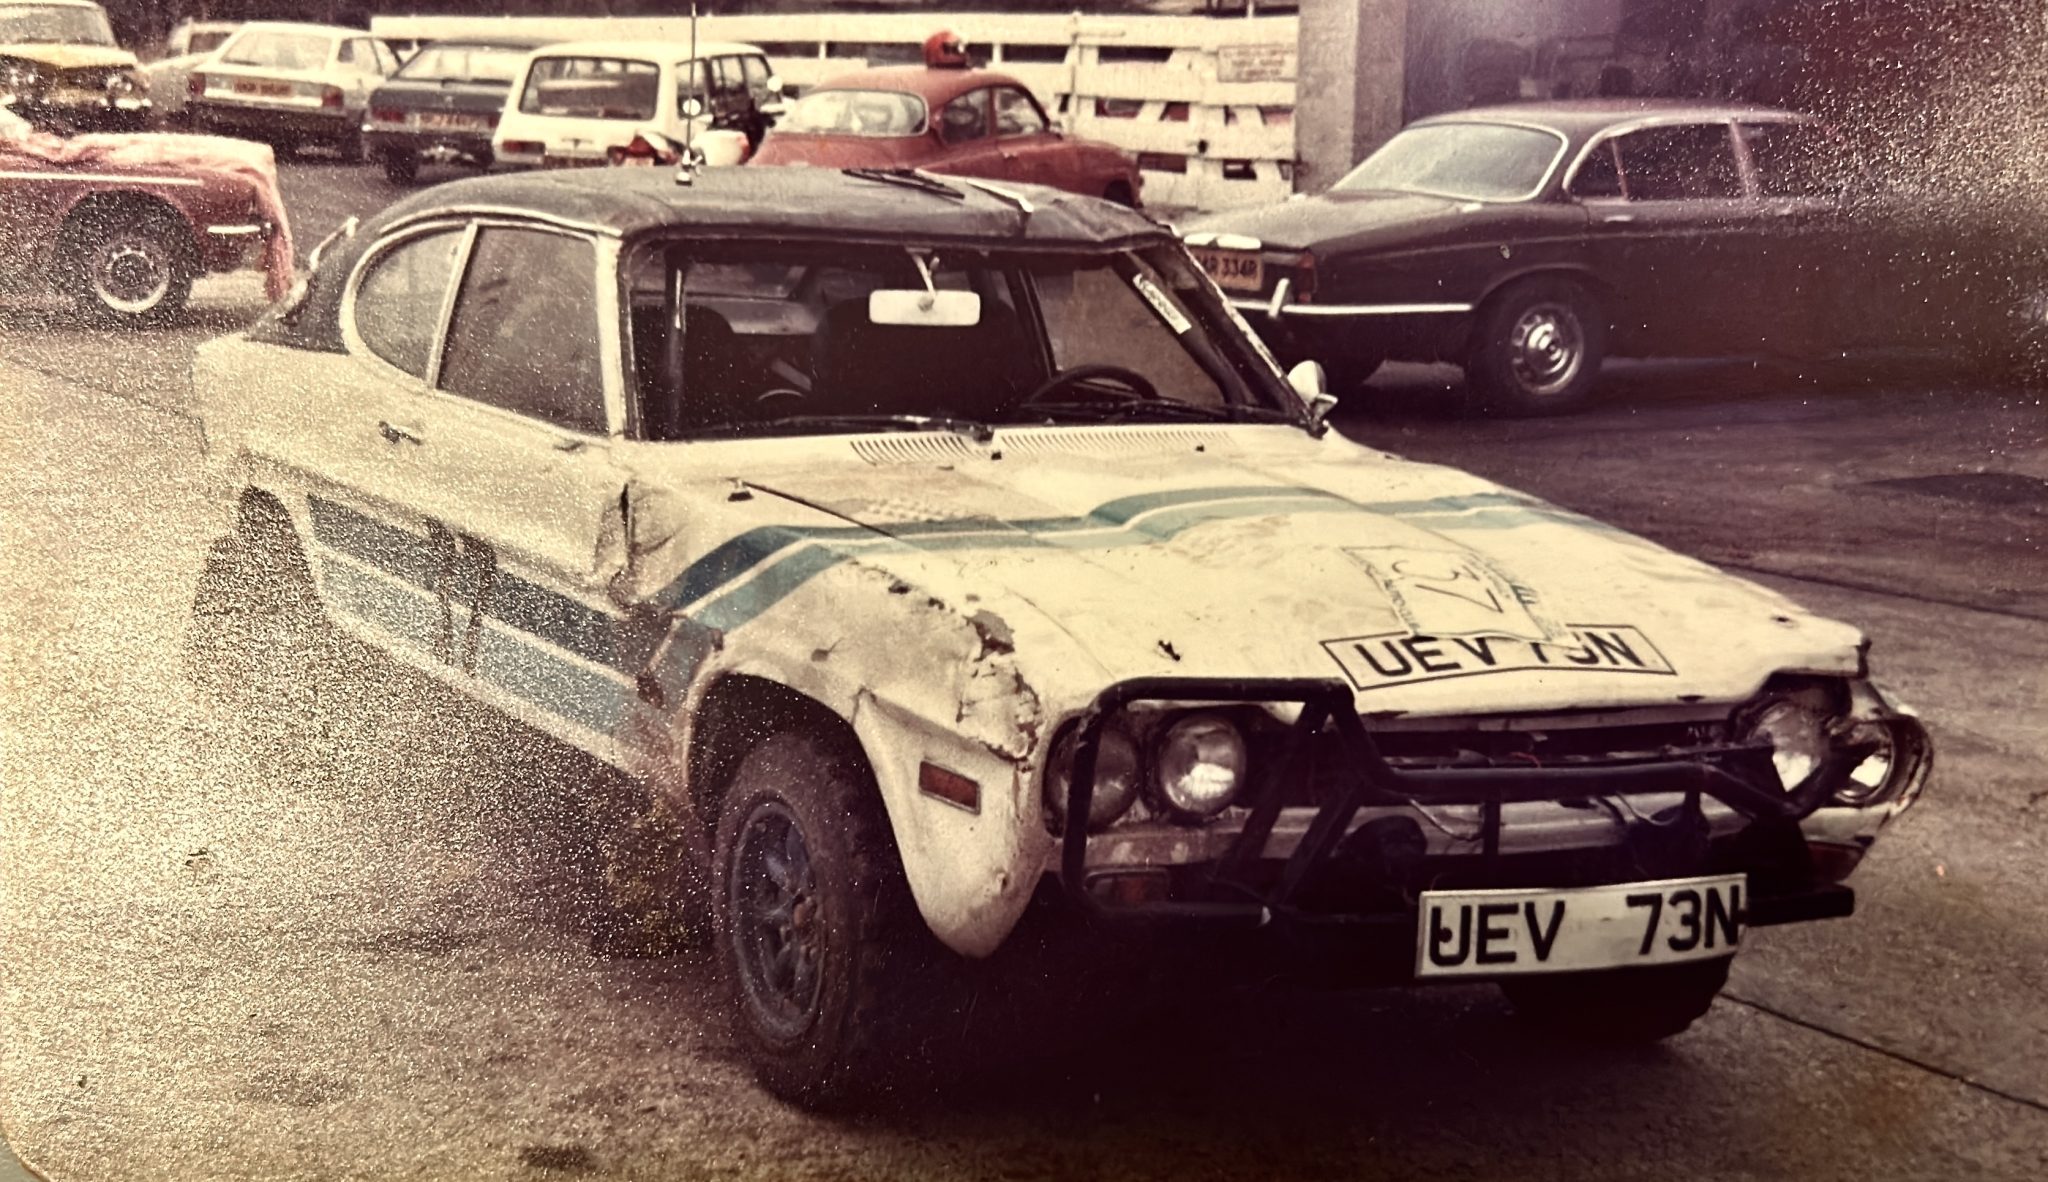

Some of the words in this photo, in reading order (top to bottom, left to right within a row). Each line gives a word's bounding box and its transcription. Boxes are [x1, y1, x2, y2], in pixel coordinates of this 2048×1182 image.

[1354, 637, 1496, 676] UEV
[1430, 903, 1565, 966] UEV
[1628, 886, 1742, 956] 73N
